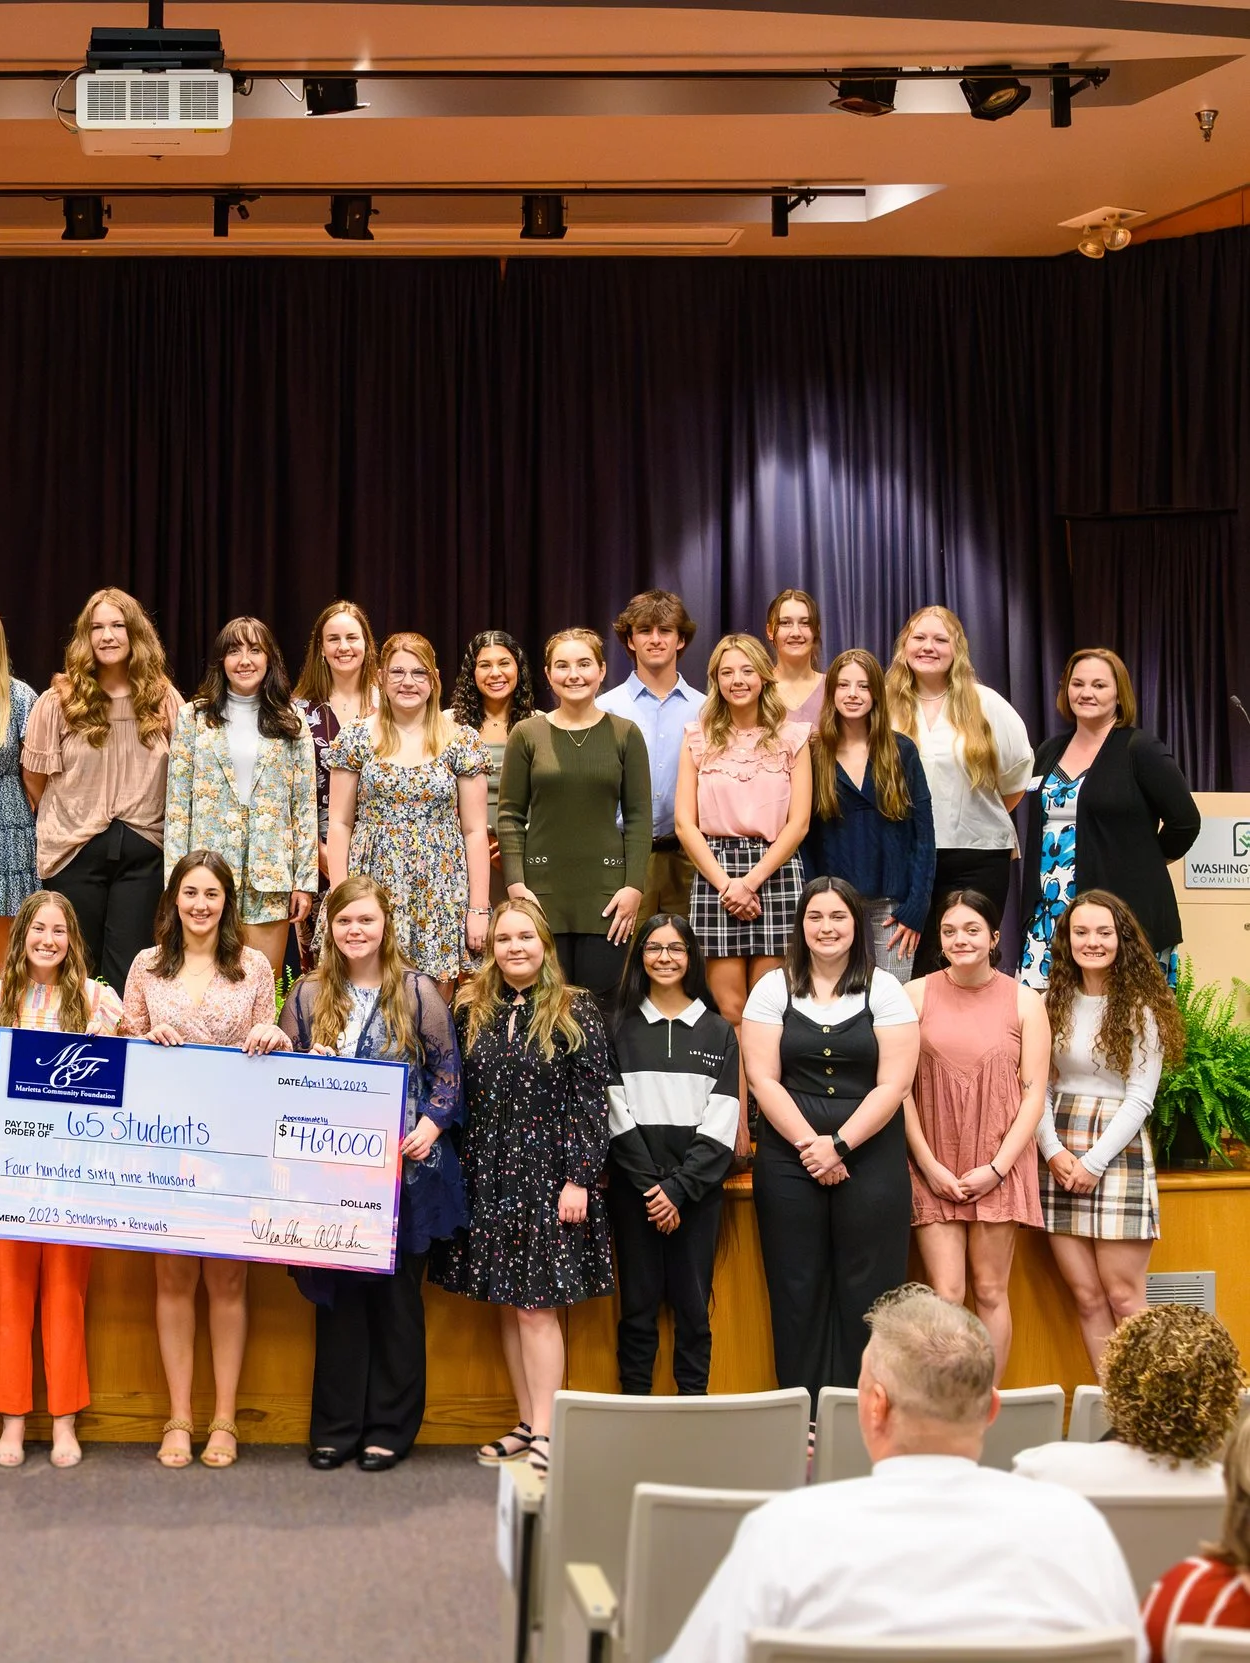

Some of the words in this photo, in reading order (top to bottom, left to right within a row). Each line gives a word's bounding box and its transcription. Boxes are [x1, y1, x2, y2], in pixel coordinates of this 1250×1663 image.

[1191, 864, 1250, 874] WASHING
[15, 1084, 41, 1093] Marietta
[42, 1087, 79, 1097] Community
[80, 1091, 116, 1100] Foundation
[278, 1077, 301, 1087] DATE
[301, 1075, 324, 1089] April
[343, 1080, 368, 1093] 2023
[4, 1120, 23, 1129] PAY
[23, 1121, 36, 1130] TO
[37, 1122, 55, 1132] THE
[4, 1127, 35, 1138] ORDER
[37, 1130, 50, 1138] OF
[67, 1111, 104, 1138] 65
[110, 1112, 210, 1146] Students
[4, 1157, 31, 1176] Four
[36, 1162, 81, 1179] hundred
[87, 1168, 116, 1186] sixty
[121, 1173, 142, 1184] nine
[146, 1171, 196, 1188] thousand
[340, 1199, 382, 1211] DOLLARS
[28, 1206, 60, 1223] 2023
[65, 1209, 118, 1228] Scholarships
[128, 1217, 168, 1233] Renewals
